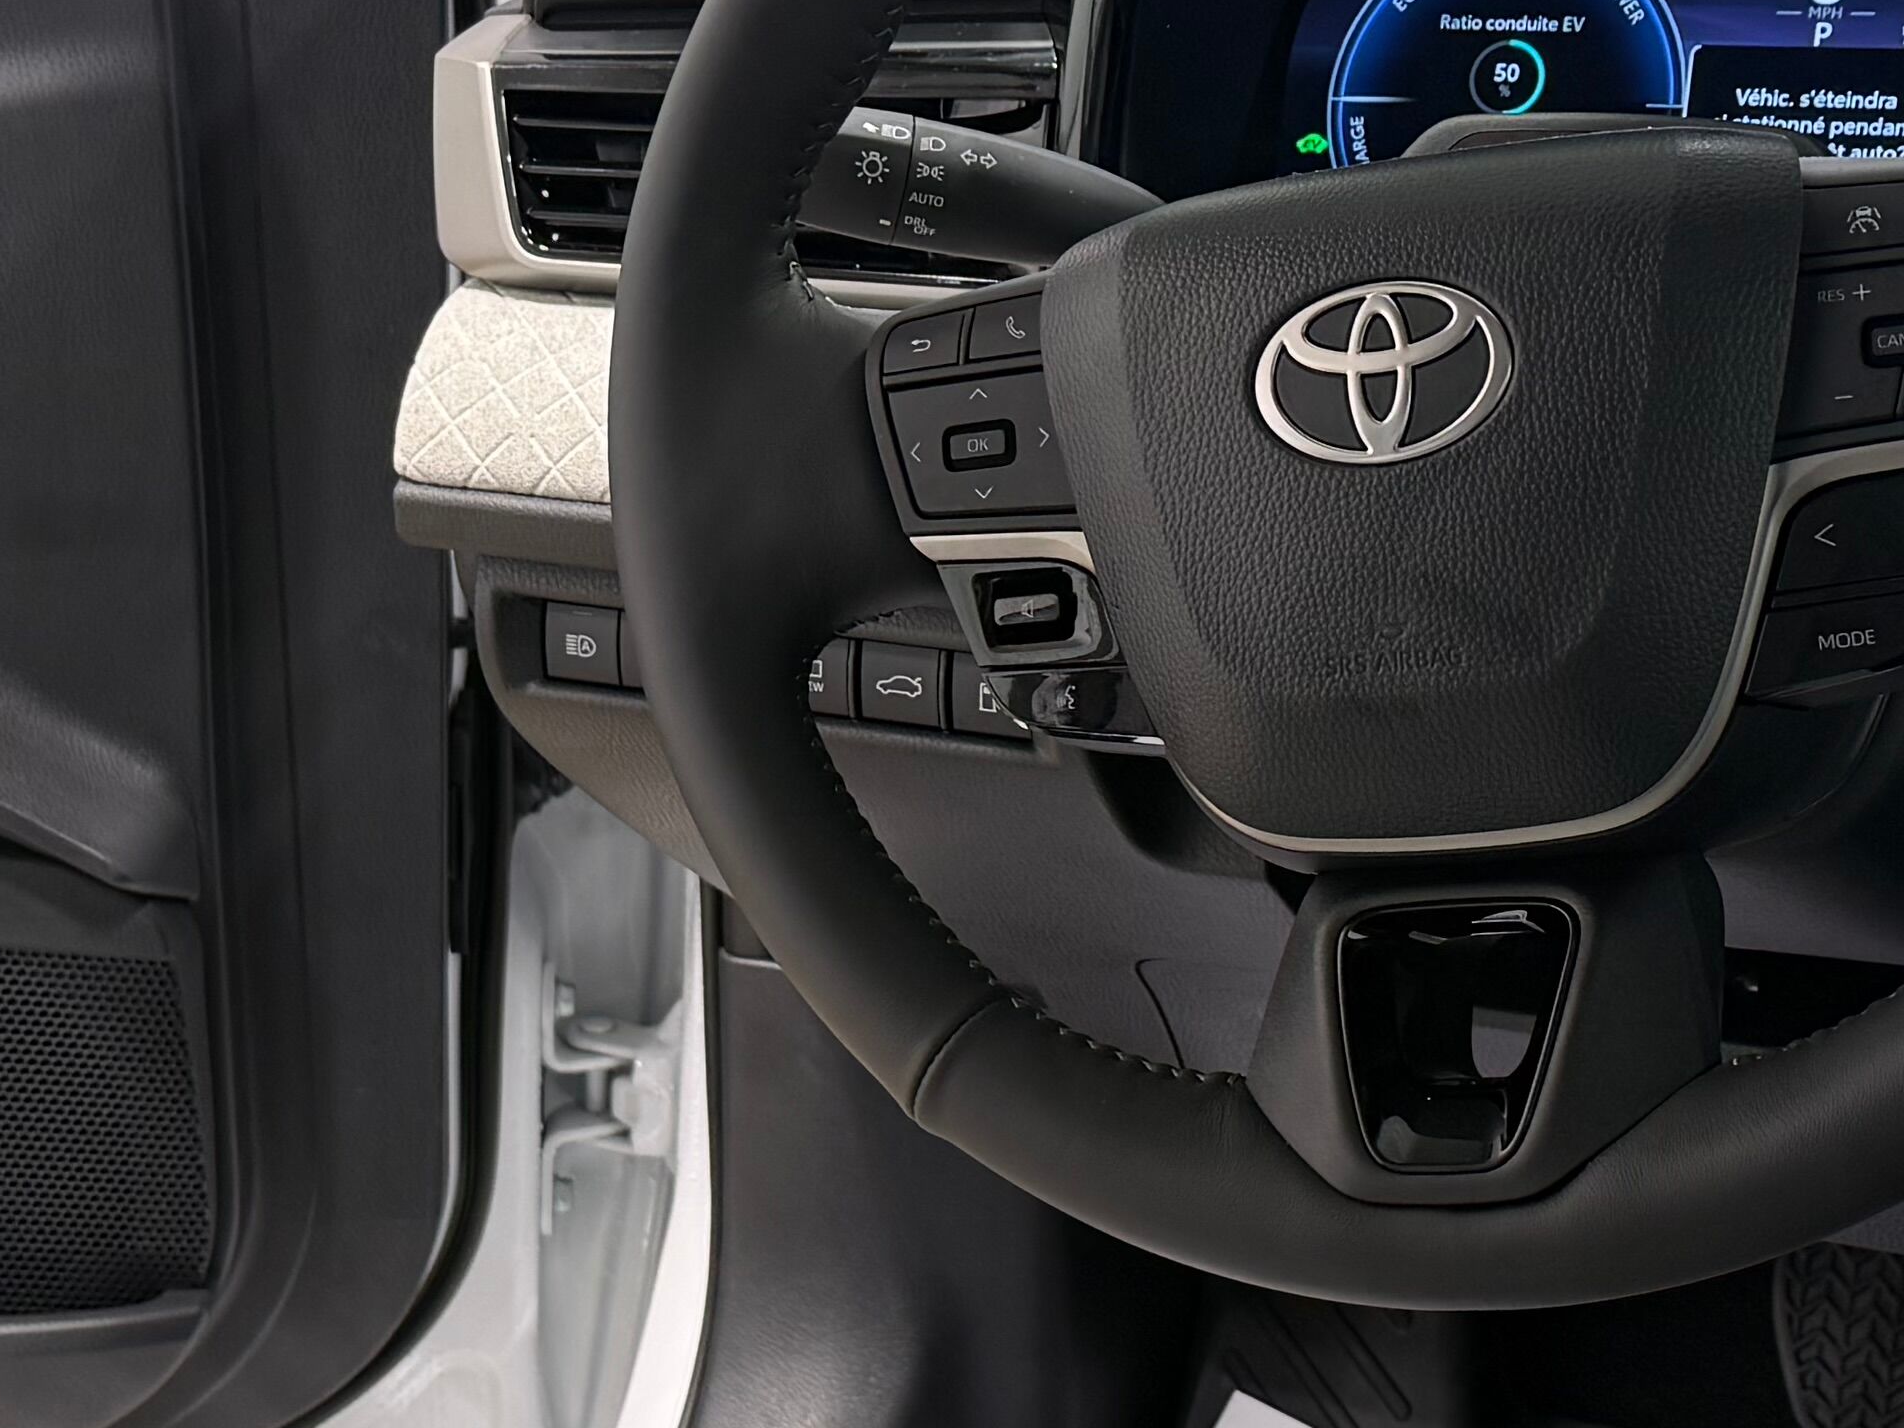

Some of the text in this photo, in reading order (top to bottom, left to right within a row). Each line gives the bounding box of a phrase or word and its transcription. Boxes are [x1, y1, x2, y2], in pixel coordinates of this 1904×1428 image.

[1807, 6, 1843, 20] MPH
[1440, 13, 1586, 33] Ratio conduite EV
[1813, 22, 1834, 47] P
[1493, 63, 1520, 83] 50
[1735, 87, 1898, 110] Véhic. s'éteindra
[908, 191, 945, 208] AUTO
[904, 215, 927, 227] DRL
[913, 225, 936, 236] OFF
[1817, 288, 1846, 303] RES
[967, 438, 989, 452] OK
[1817, 628, 1877, 651] MODE
